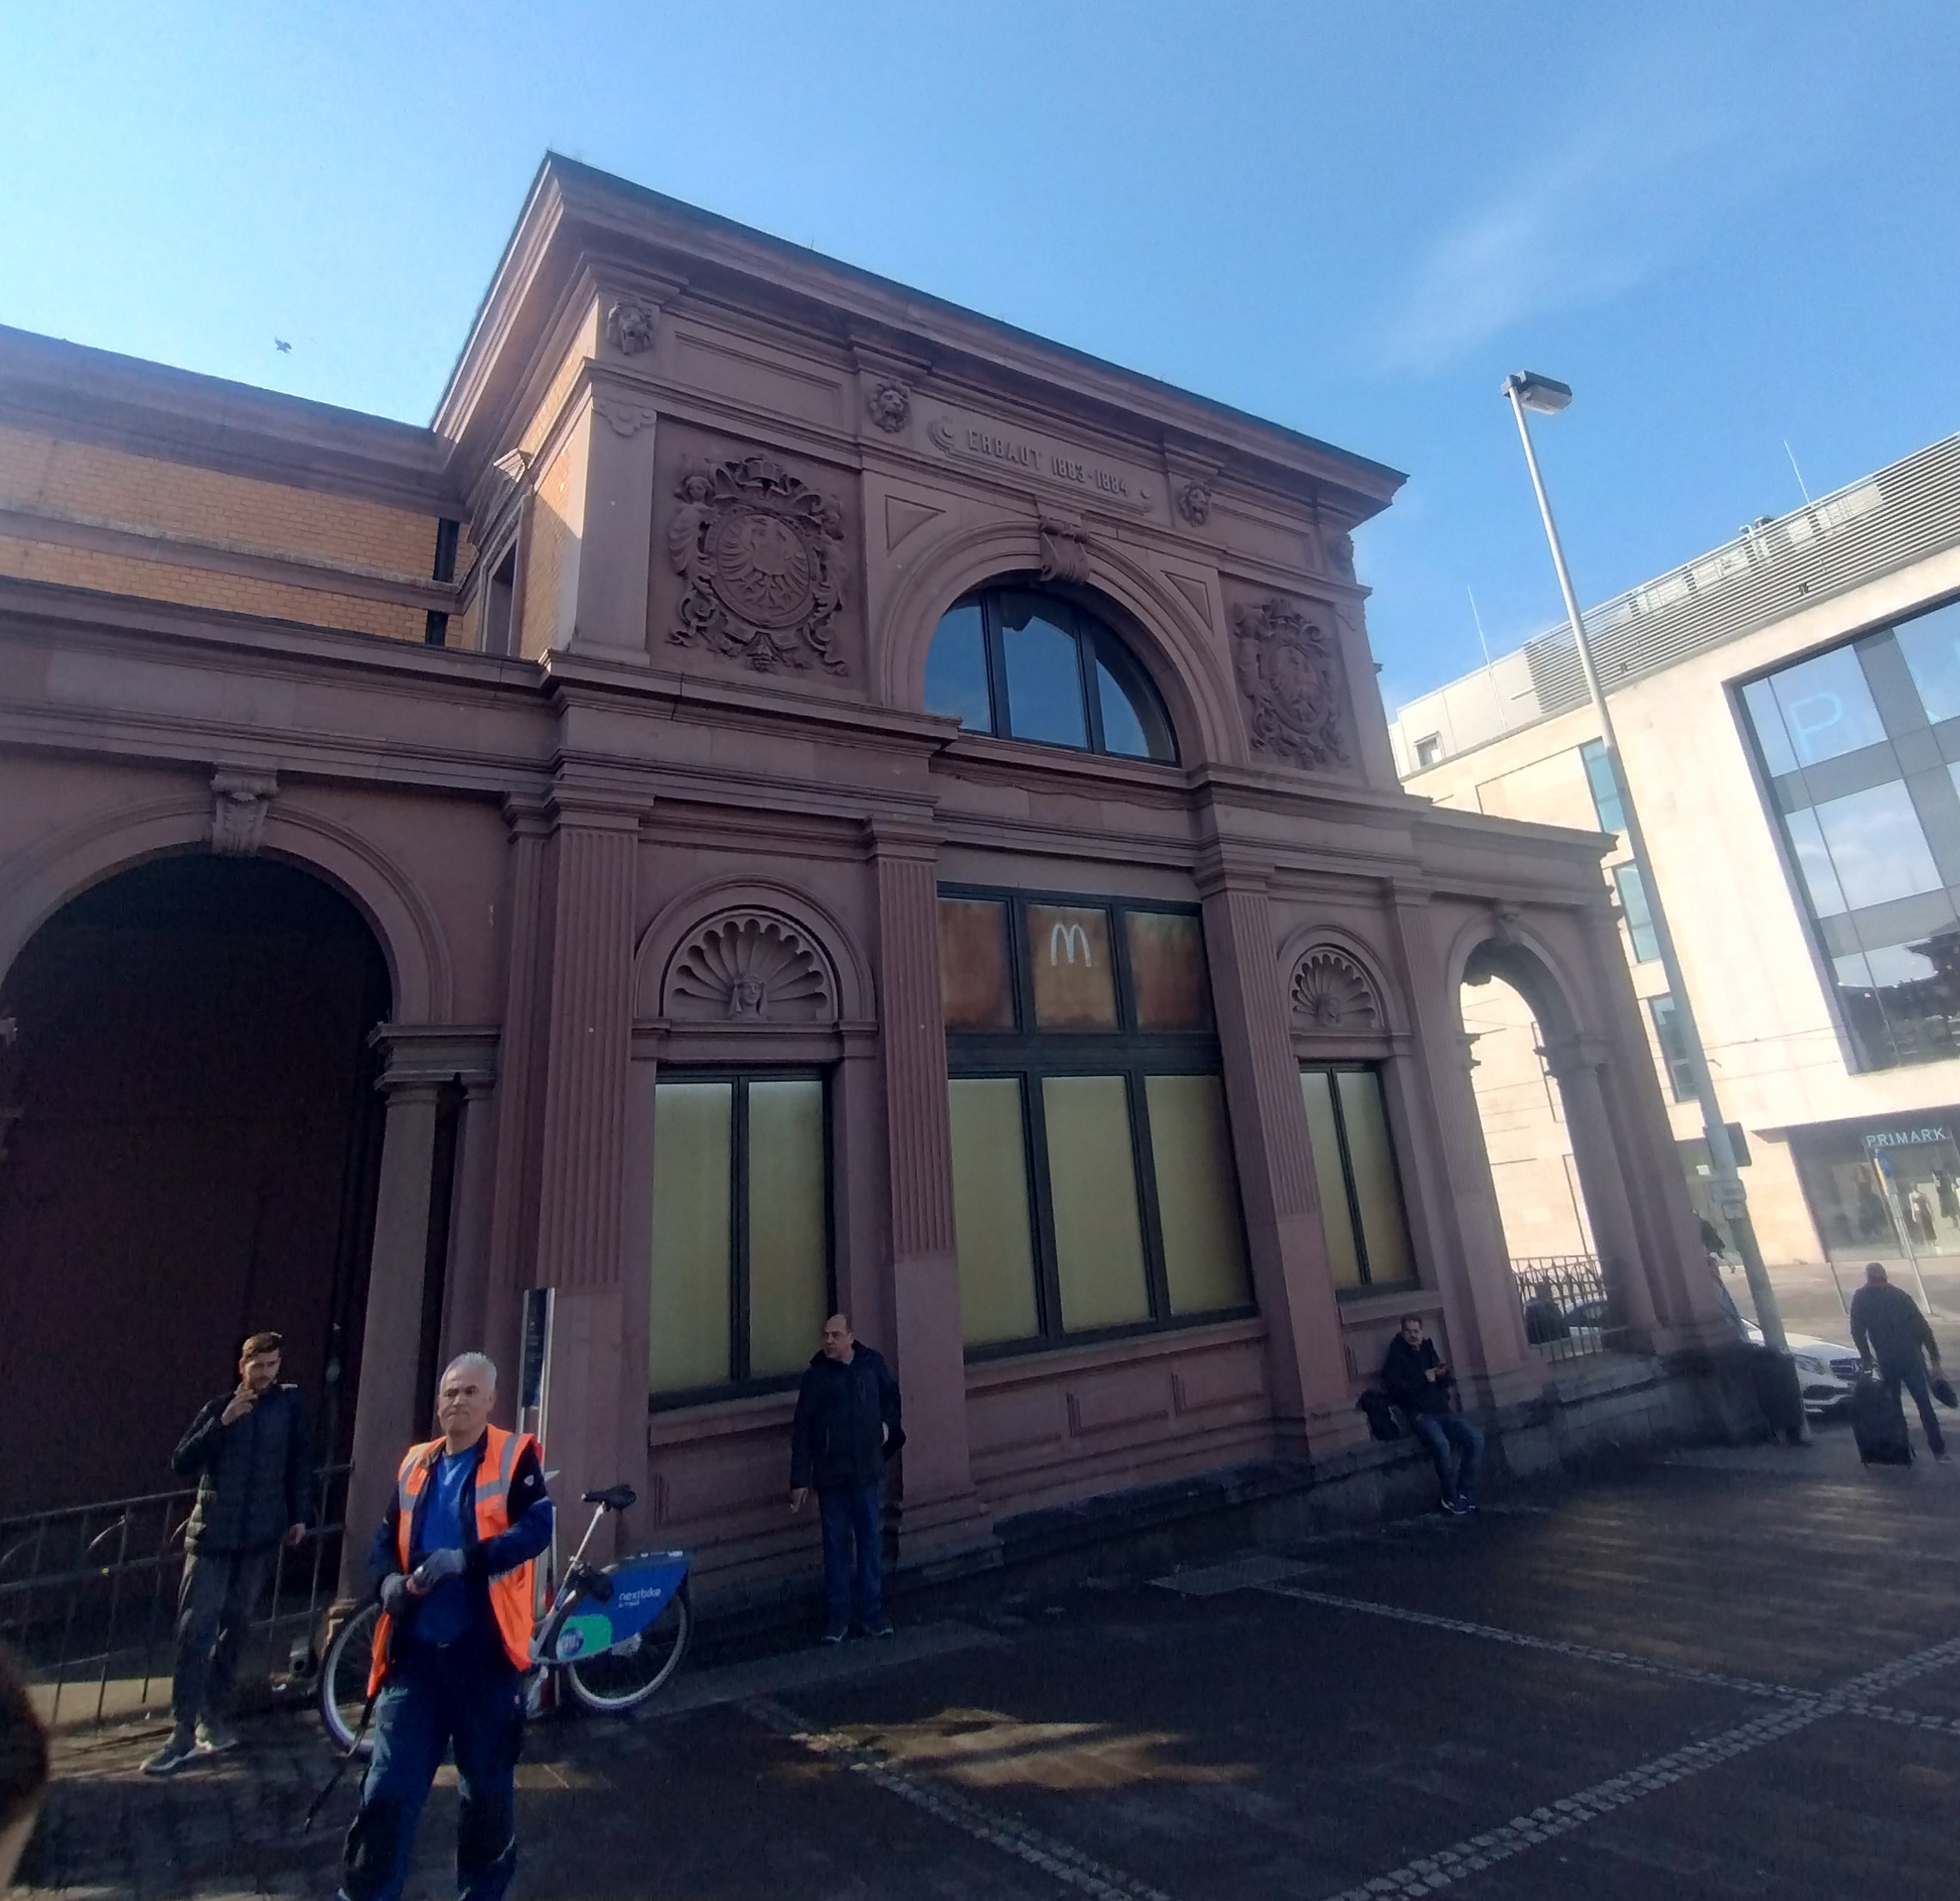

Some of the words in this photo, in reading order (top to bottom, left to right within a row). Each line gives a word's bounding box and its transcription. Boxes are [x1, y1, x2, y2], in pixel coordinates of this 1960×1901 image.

[968, 429, 1041, 470] ERBAUT
[1865, 1127, 1946, 1147] PRIMARK
[619, 1586, 662, 1601] nextbike
